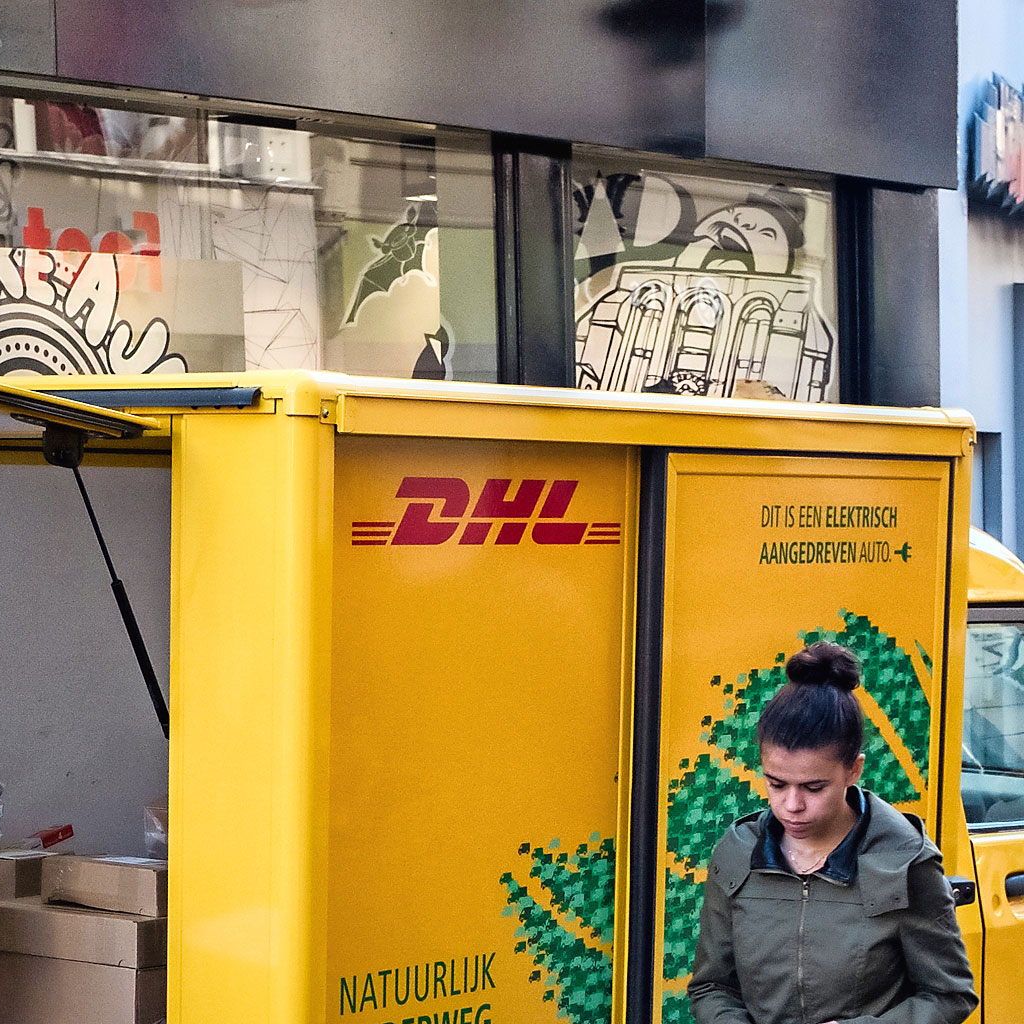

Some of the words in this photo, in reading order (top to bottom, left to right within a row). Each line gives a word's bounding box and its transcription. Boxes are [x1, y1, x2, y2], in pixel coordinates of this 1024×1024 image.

[391, 476, 586, 546] DHL
[761, 505, 781, 528] DIT
[785, 505, 795, 528] IS
[799, 505, 822, 528] EEN
[826, 505, 898, 528] ELEKTRISCH
[759, 541, 856, 565] AANGEDREVEN
[859, 541, 892, 563] AUTO.
[339, 952, 496, 1016] NATUURLIJK
